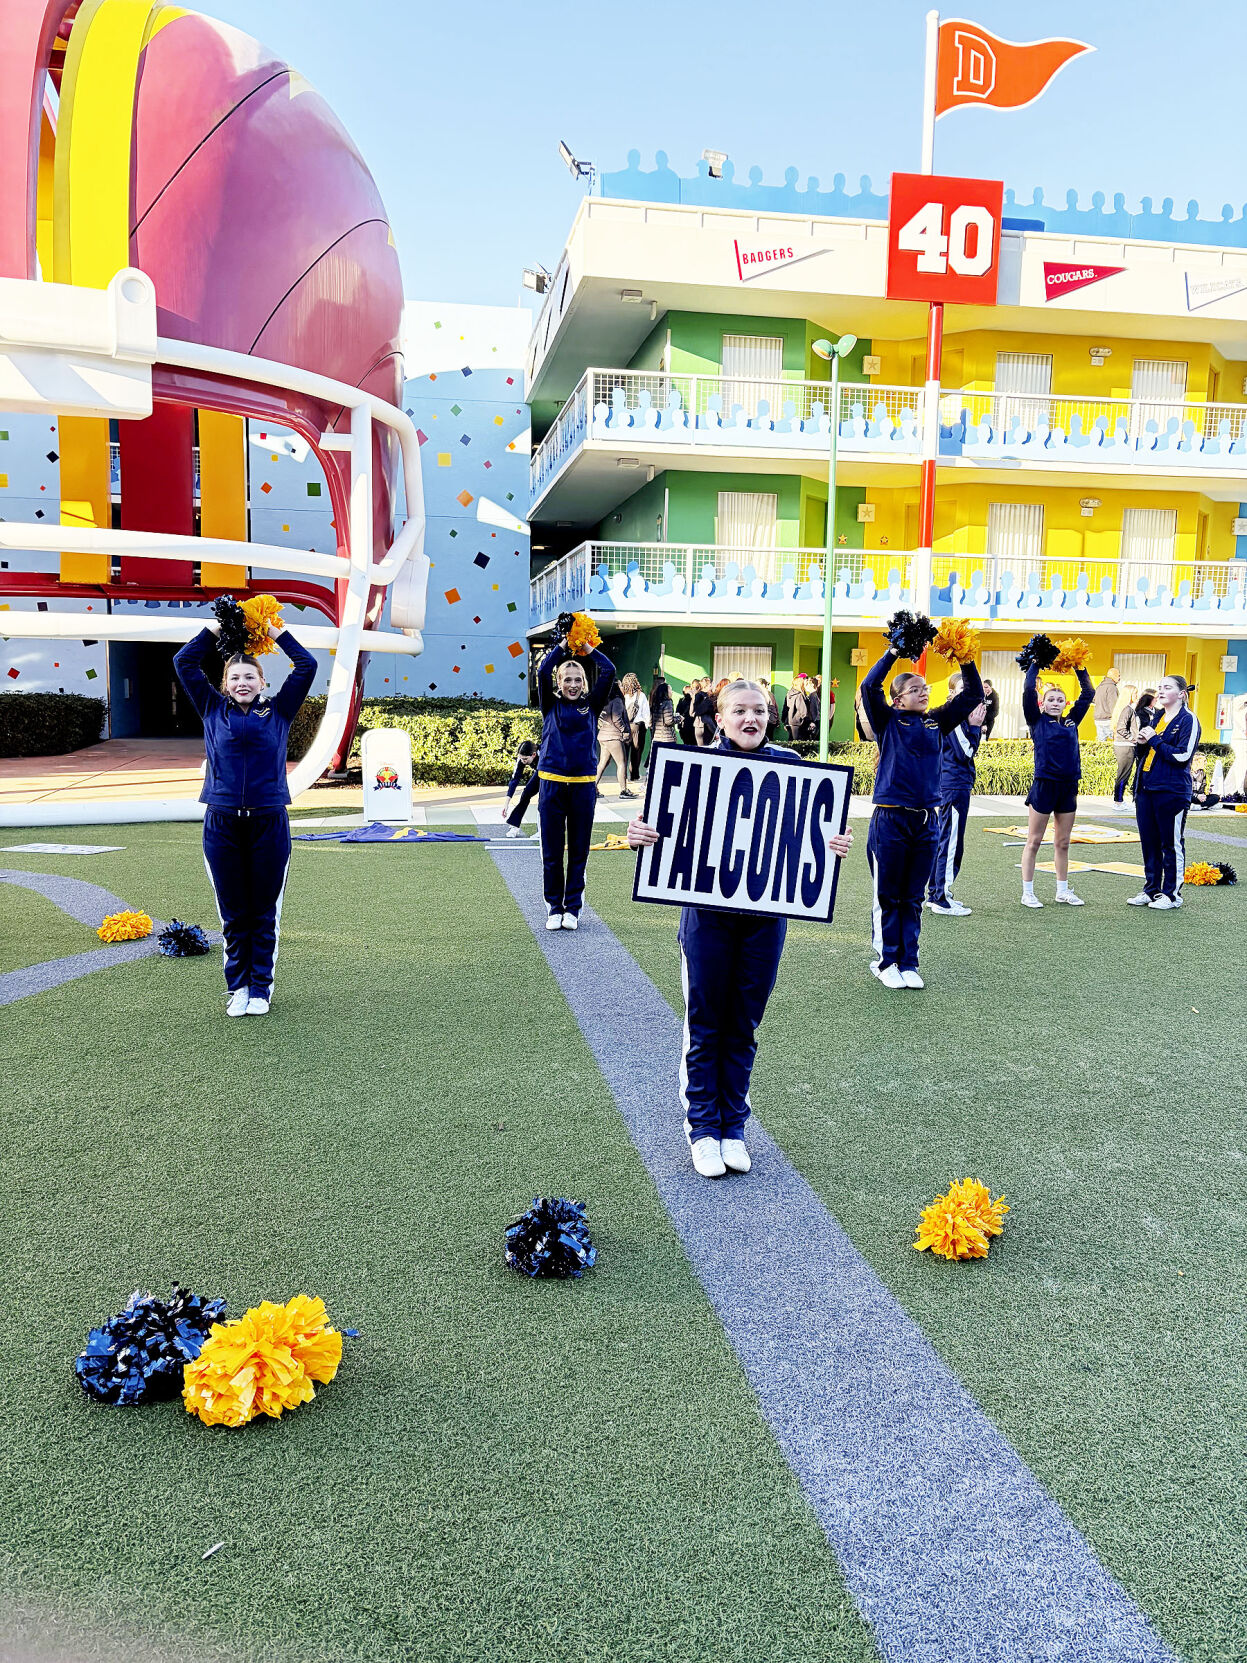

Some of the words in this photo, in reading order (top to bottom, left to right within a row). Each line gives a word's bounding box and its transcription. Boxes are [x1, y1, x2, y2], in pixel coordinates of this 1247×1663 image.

[953, 31, 996, 99] D
[742, 247, 794, 265] BADGERS
[898, 202, 995, 277] 40
[648, 760, 835, 908] FALCONS
